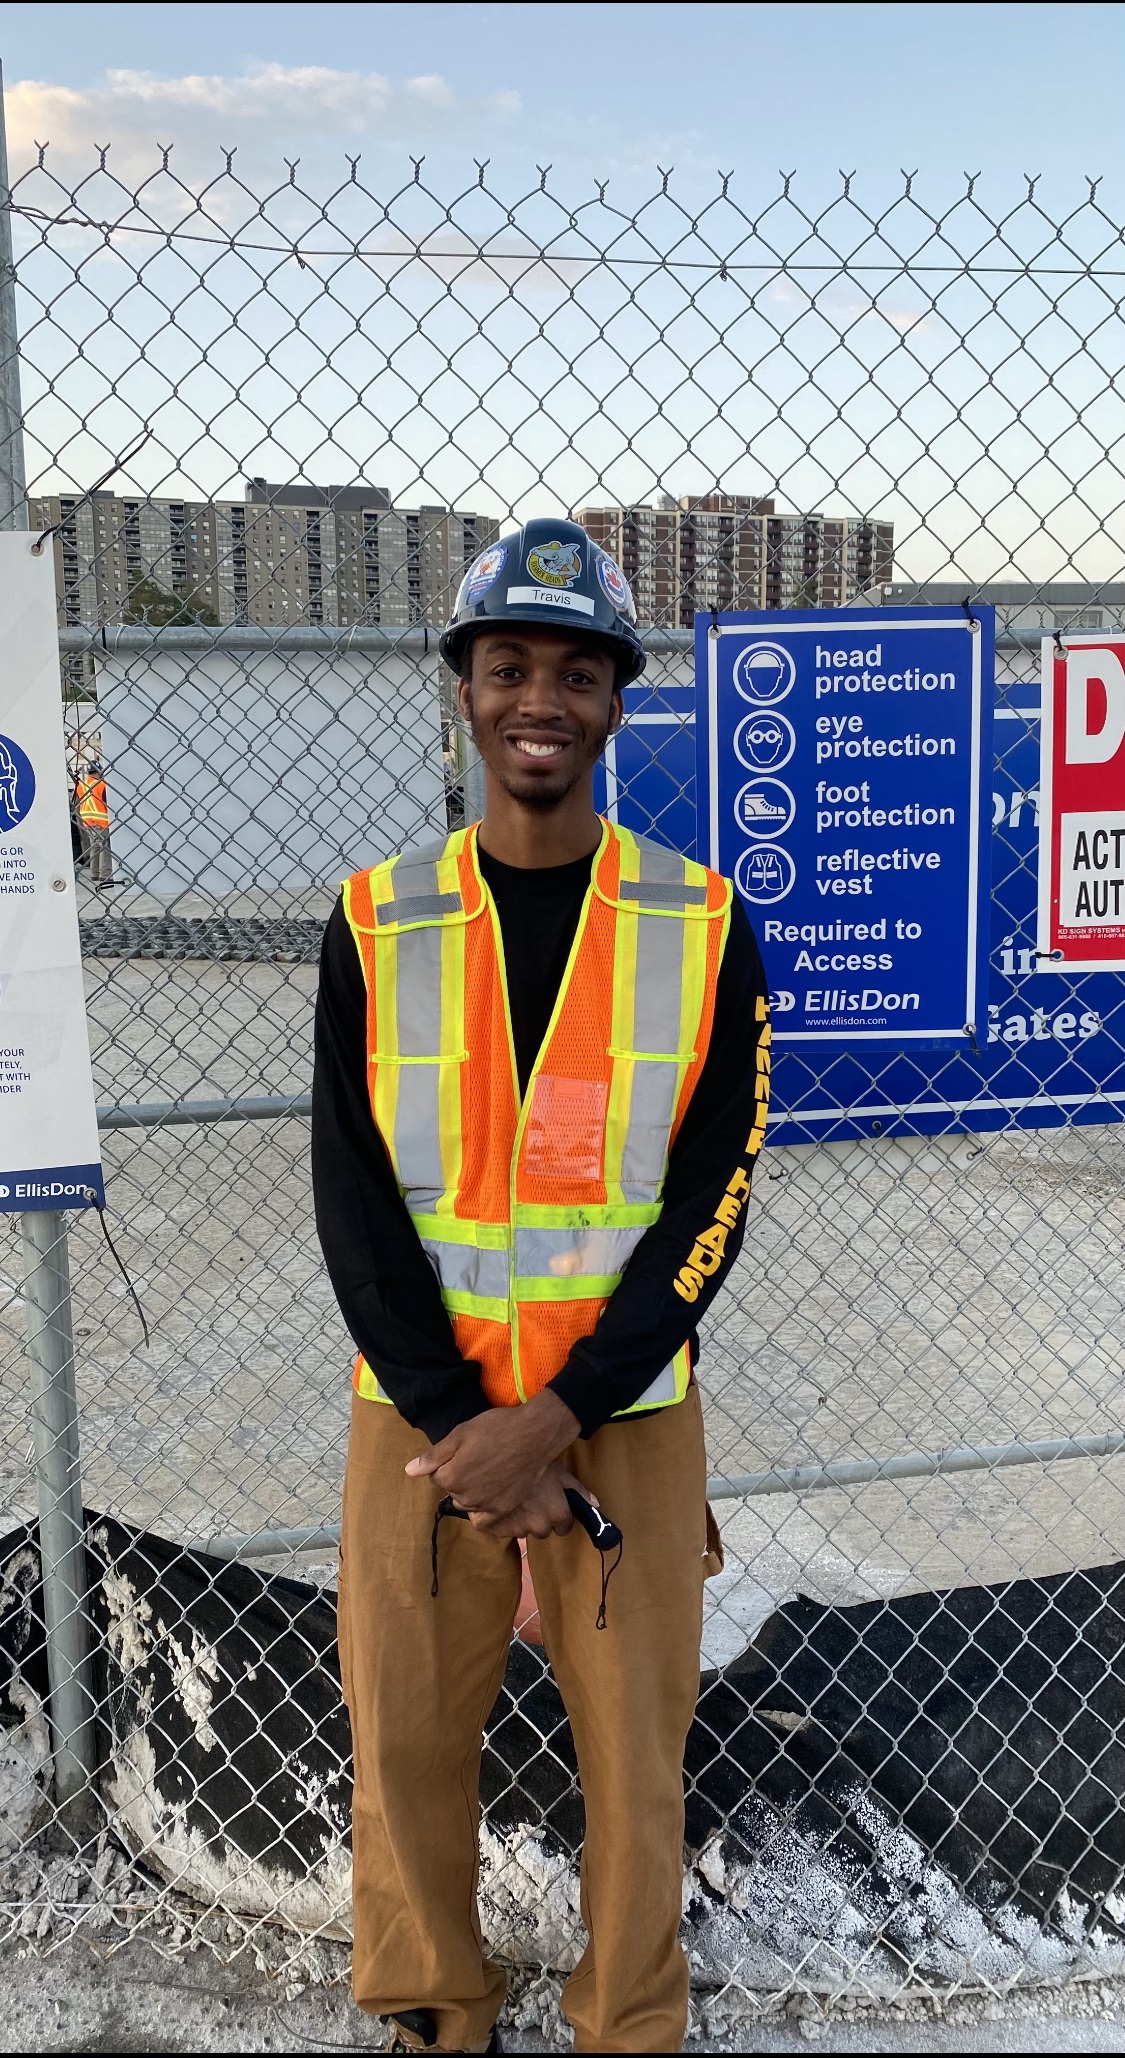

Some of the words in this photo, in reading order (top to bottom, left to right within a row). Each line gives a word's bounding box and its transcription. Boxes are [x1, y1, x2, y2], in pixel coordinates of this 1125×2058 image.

[532, 589, 571, 605] Travis
[815, 643, 882, 668] head
[815, 669, 956, 699] protection
[816, 716, 863, 739] eye
[815, 735, 956, 764] protection
[816, 781, 870, 803] foot
[816, 804, 955, 833] protection
[9, 846, 24, 856] OR
[816, 848, 941, 872] reflective
[3, 859, 27, 869] INTO
[13, 872, 35, 881] AND
[816, 873, 873, 896] vest
[0, 884, 35, 894] HANDS
[764, 918, 887, 947] Required
[895, 918, 922, 941] to
[793, 950, 894, 972] Access
[805, 989, 920, 1011] EllisDon
[805, 1017, 887, 1026] www.ellisdon.com
[5, 1072, 31, 1081] WITH
[15, 1182, 87, 1198] EllisDon
[673, 1166, 752, 1303] HEADS
